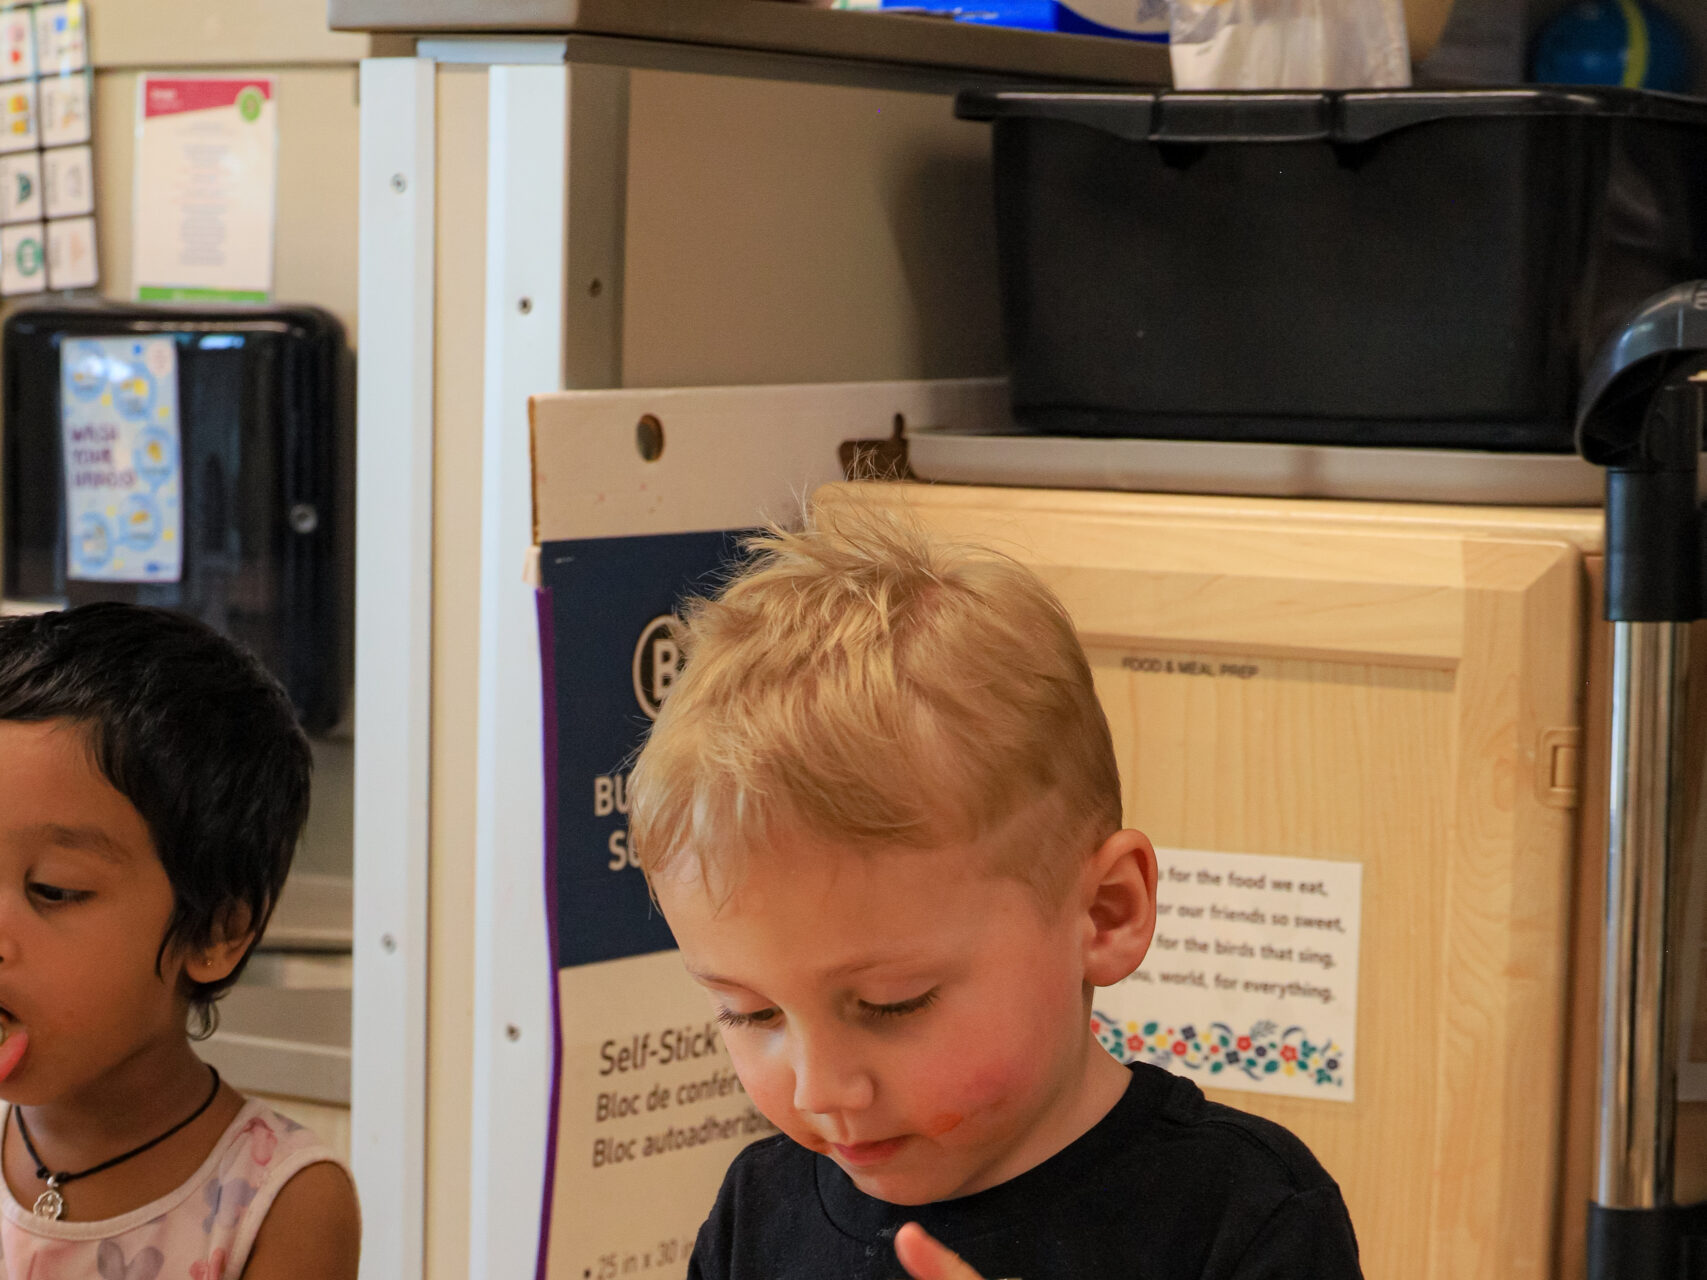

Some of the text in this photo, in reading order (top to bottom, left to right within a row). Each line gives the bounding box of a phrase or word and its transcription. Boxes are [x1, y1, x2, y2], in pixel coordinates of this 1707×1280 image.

[1121, 657, 1162, 672] FOOD
[1177, 661, 1216, 677] MEAL
[1219, 663, 1259, 680] PREP
[1168, 867, 1191, 883] for
[1197, 869, 1221, 886] the
[1228, 872, 1267, 890] food
[1272, 881, 1293, 892] we
[1156, 904, 1174, 915] or
[1177, 905, 1204, 919] our
[1210, 904, 1266, 925] friends
[1272, 914, 1289, 928] so
[1156, 933, 1179, 950] for
[1184, 937, 1209, 953] the
[1215, 939, 1255, 958] birds
[1261, 945, 1293, 962] that
[1215, 974, 1238, 992] for
[599, 1022, 719, 1078] Self-Stick
[596, 1089, 641, 1123] Bloc
[646, 1081, 671, 1113] de
[593, 1137, 637, 1168] Bloc
[622, 1253, 638, 1275] in
[656, 1237, 679, 1268] 30
